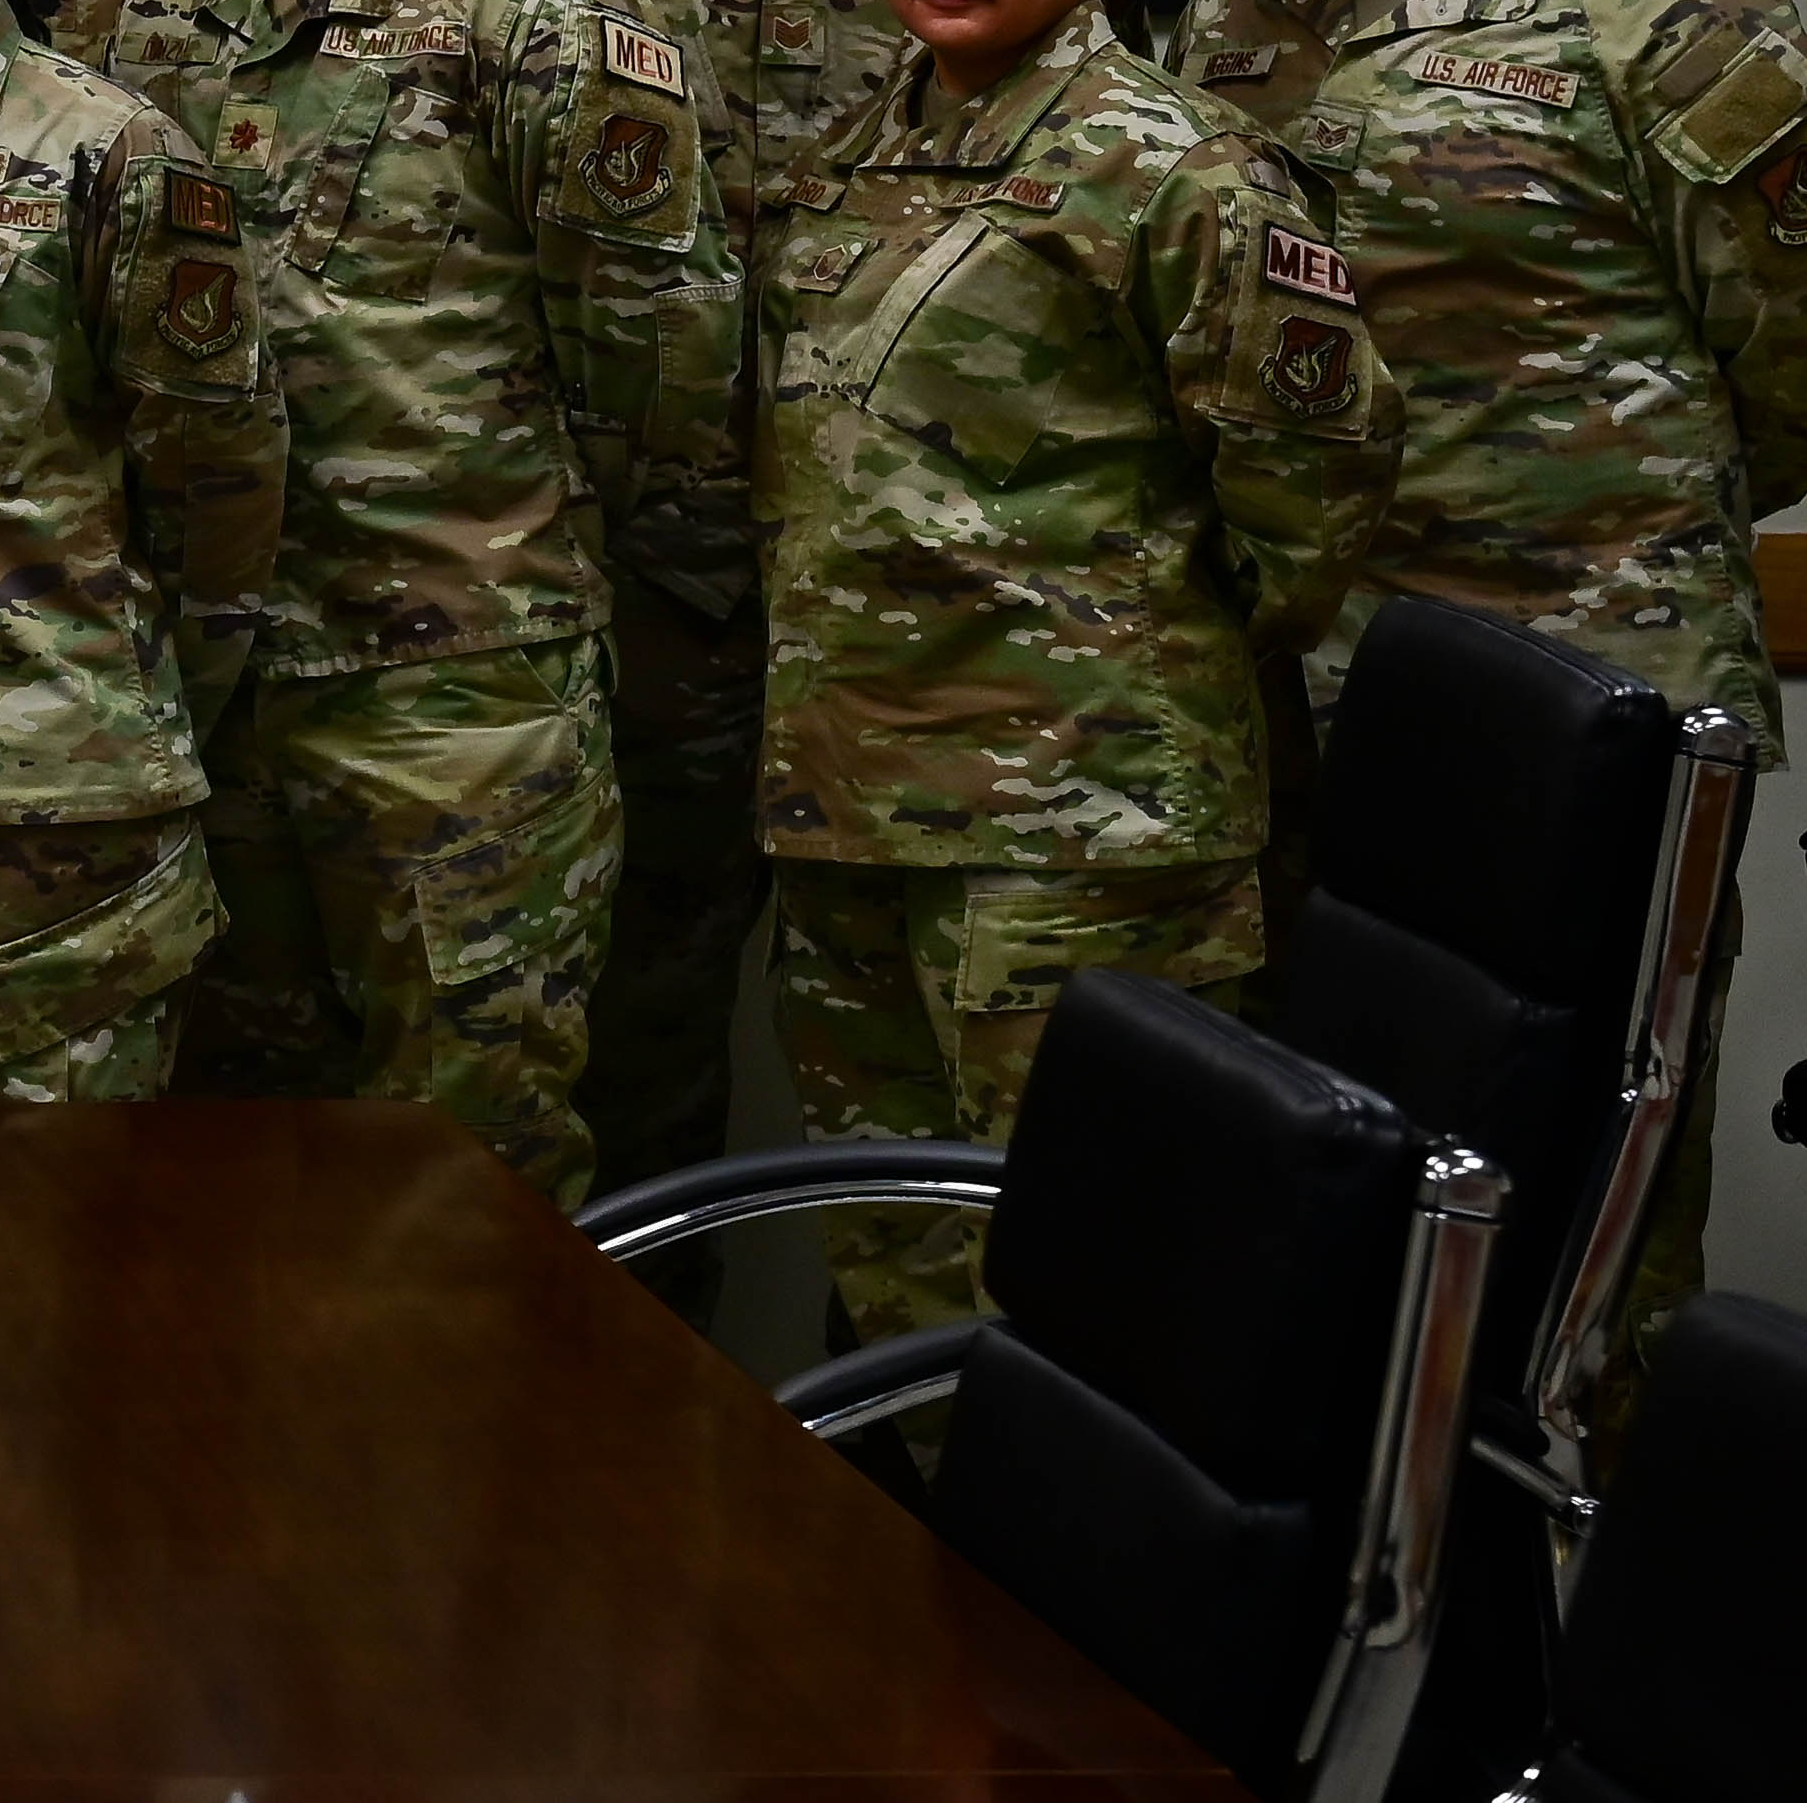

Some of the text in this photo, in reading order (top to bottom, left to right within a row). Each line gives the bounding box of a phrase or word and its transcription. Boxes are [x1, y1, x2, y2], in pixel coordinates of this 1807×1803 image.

[363, 33, 396, 57] AIR
[398, 26, 460, 55] FORCE
[615, 29, 673, 83] MED
[1422, 53, 1569, 103] U.S. AIR FORCE
[172, 177, 230, 233] MED
[1269, 234, 1352, 295] MED
